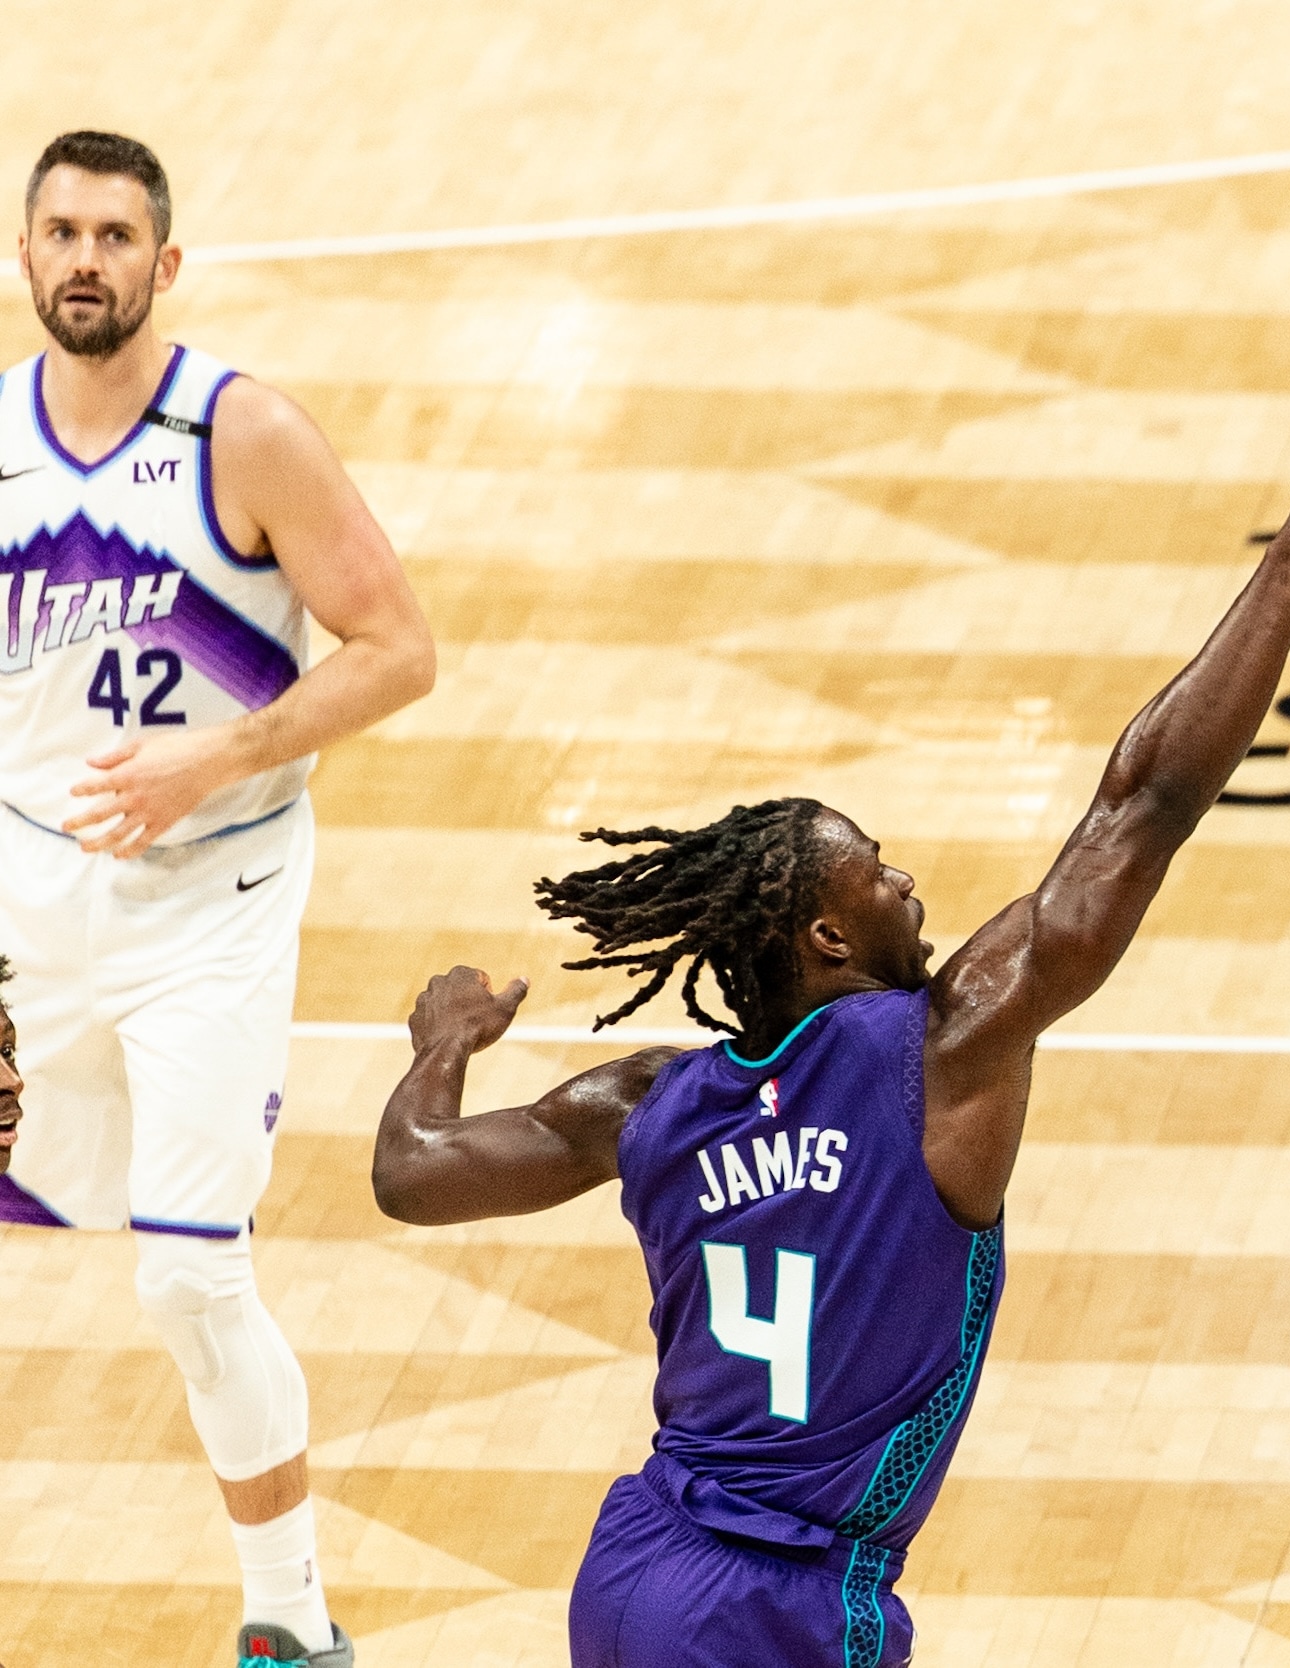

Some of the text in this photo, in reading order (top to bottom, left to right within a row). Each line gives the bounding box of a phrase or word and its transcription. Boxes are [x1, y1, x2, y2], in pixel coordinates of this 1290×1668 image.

[132, 459, 183, 484] LVT
[0, 567, 189, 676] UTAH
[87, 646, 187, 728] 42
[696, 1126, 849, 1214] JAMES
[700, 1240, 816, 1425] 4
